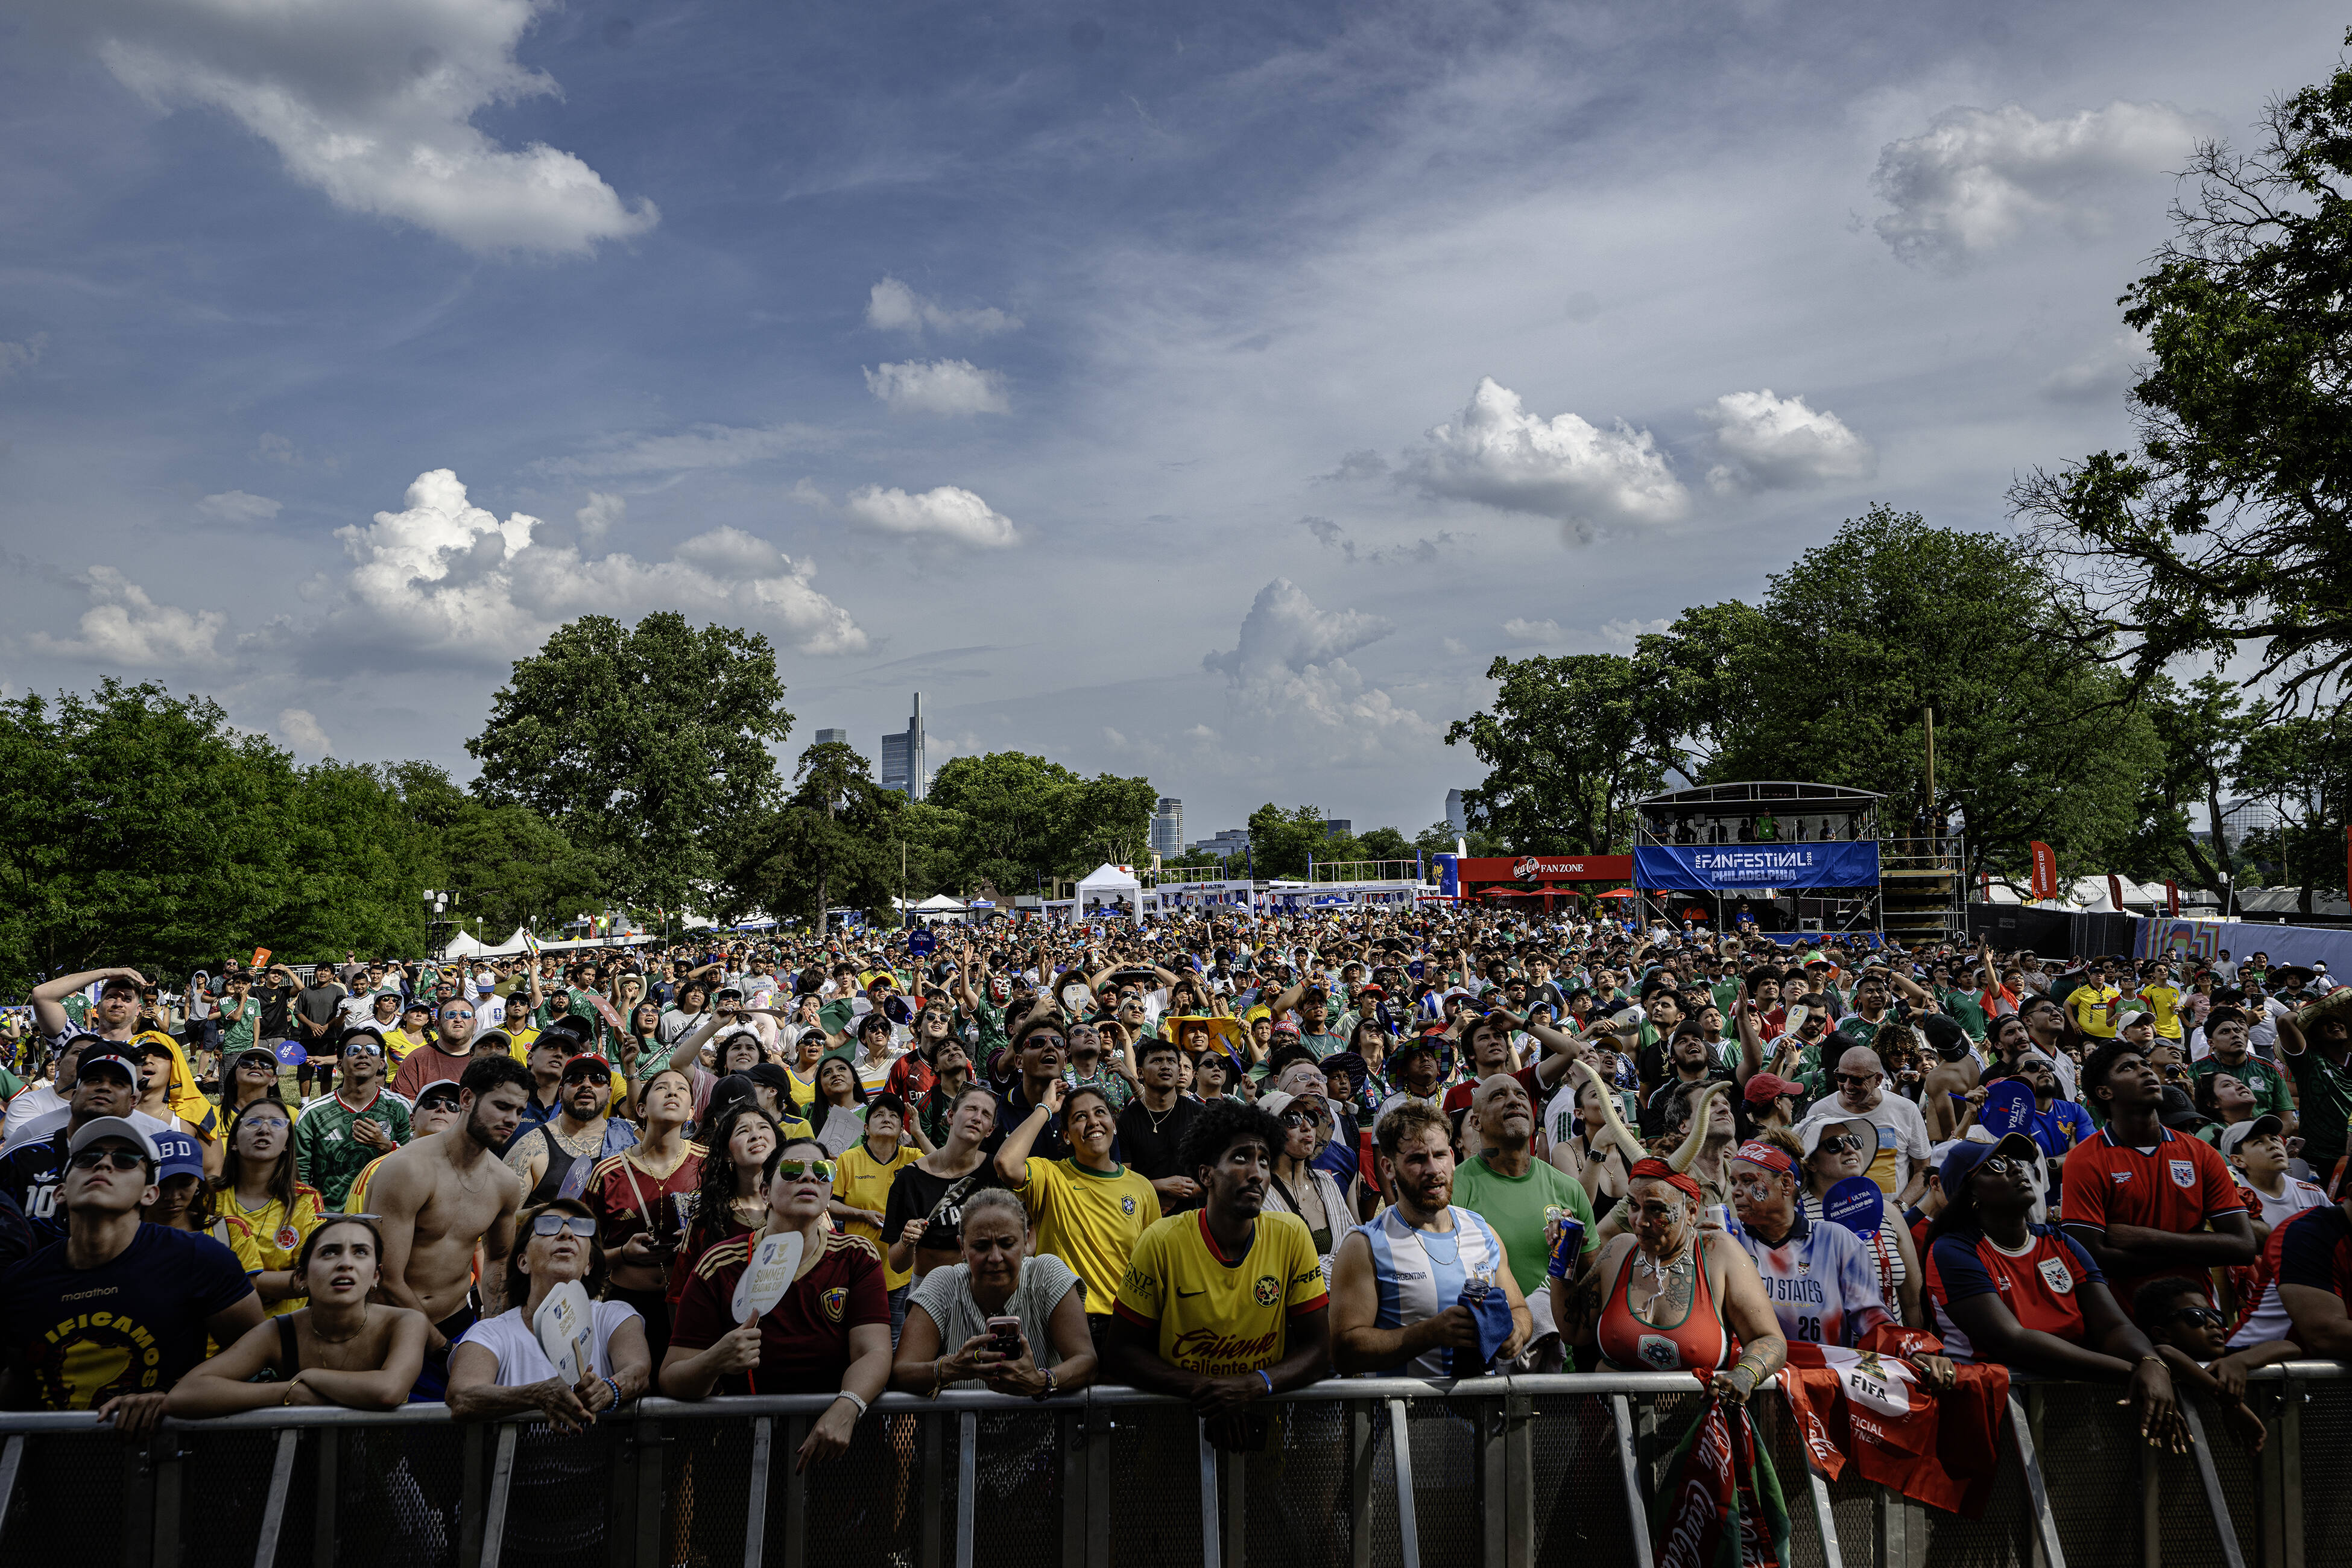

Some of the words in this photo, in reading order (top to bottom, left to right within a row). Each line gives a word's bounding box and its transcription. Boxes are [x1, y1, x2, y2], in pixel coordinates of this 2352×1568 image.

[1560, 864, 1584, 873] ZONE
[1712, 870, 1797, 882] PHILADELPHIA
[2039, 862, 2048, 891] EMERGENCY
[1275, 1022, 1297, 1032] Coca-Cola
[282, 1045, 293, 1058] ULTRA
[2008, 1097, 2022, 1128] ULTRA
[159, 1140, 192, 1158] BD
[25, 1185, 58, 1218] 10
[1851, 1191, 1871, 1201] ULTRA
[1839, 1206, 1855, 1215] WORLD
[1877, 1239, 1887, 1259] Phillies
[2040, 1259, 2060, 1268] PANAMA
[754, 1266, 786, 1283] SUMMER
[1393, 1271, 1427, 1282] ARGENTINA
[61, 1286, 119, 1303] marathon
[751, 1283, 771, 1294] READING
[772, 1281, 783, 1291] CUP
[1124, 1280, 1148, 1300] GUROS
[1762, 1276, 1773, 1298] D
[1778, 1279, 1823, 1303] STATES
[1798, 1316, 1821, 1342] 26
[1172, 1327, 1276, 1359] Caliente
[1181, 1352, 1272, 1376] caliente.mx
[1850, 1374, 1889, 1403] FIFA
[1850, 1414, 1885, 1438] FICIAL
[1853, 1427, 1882, 1446] TNER
